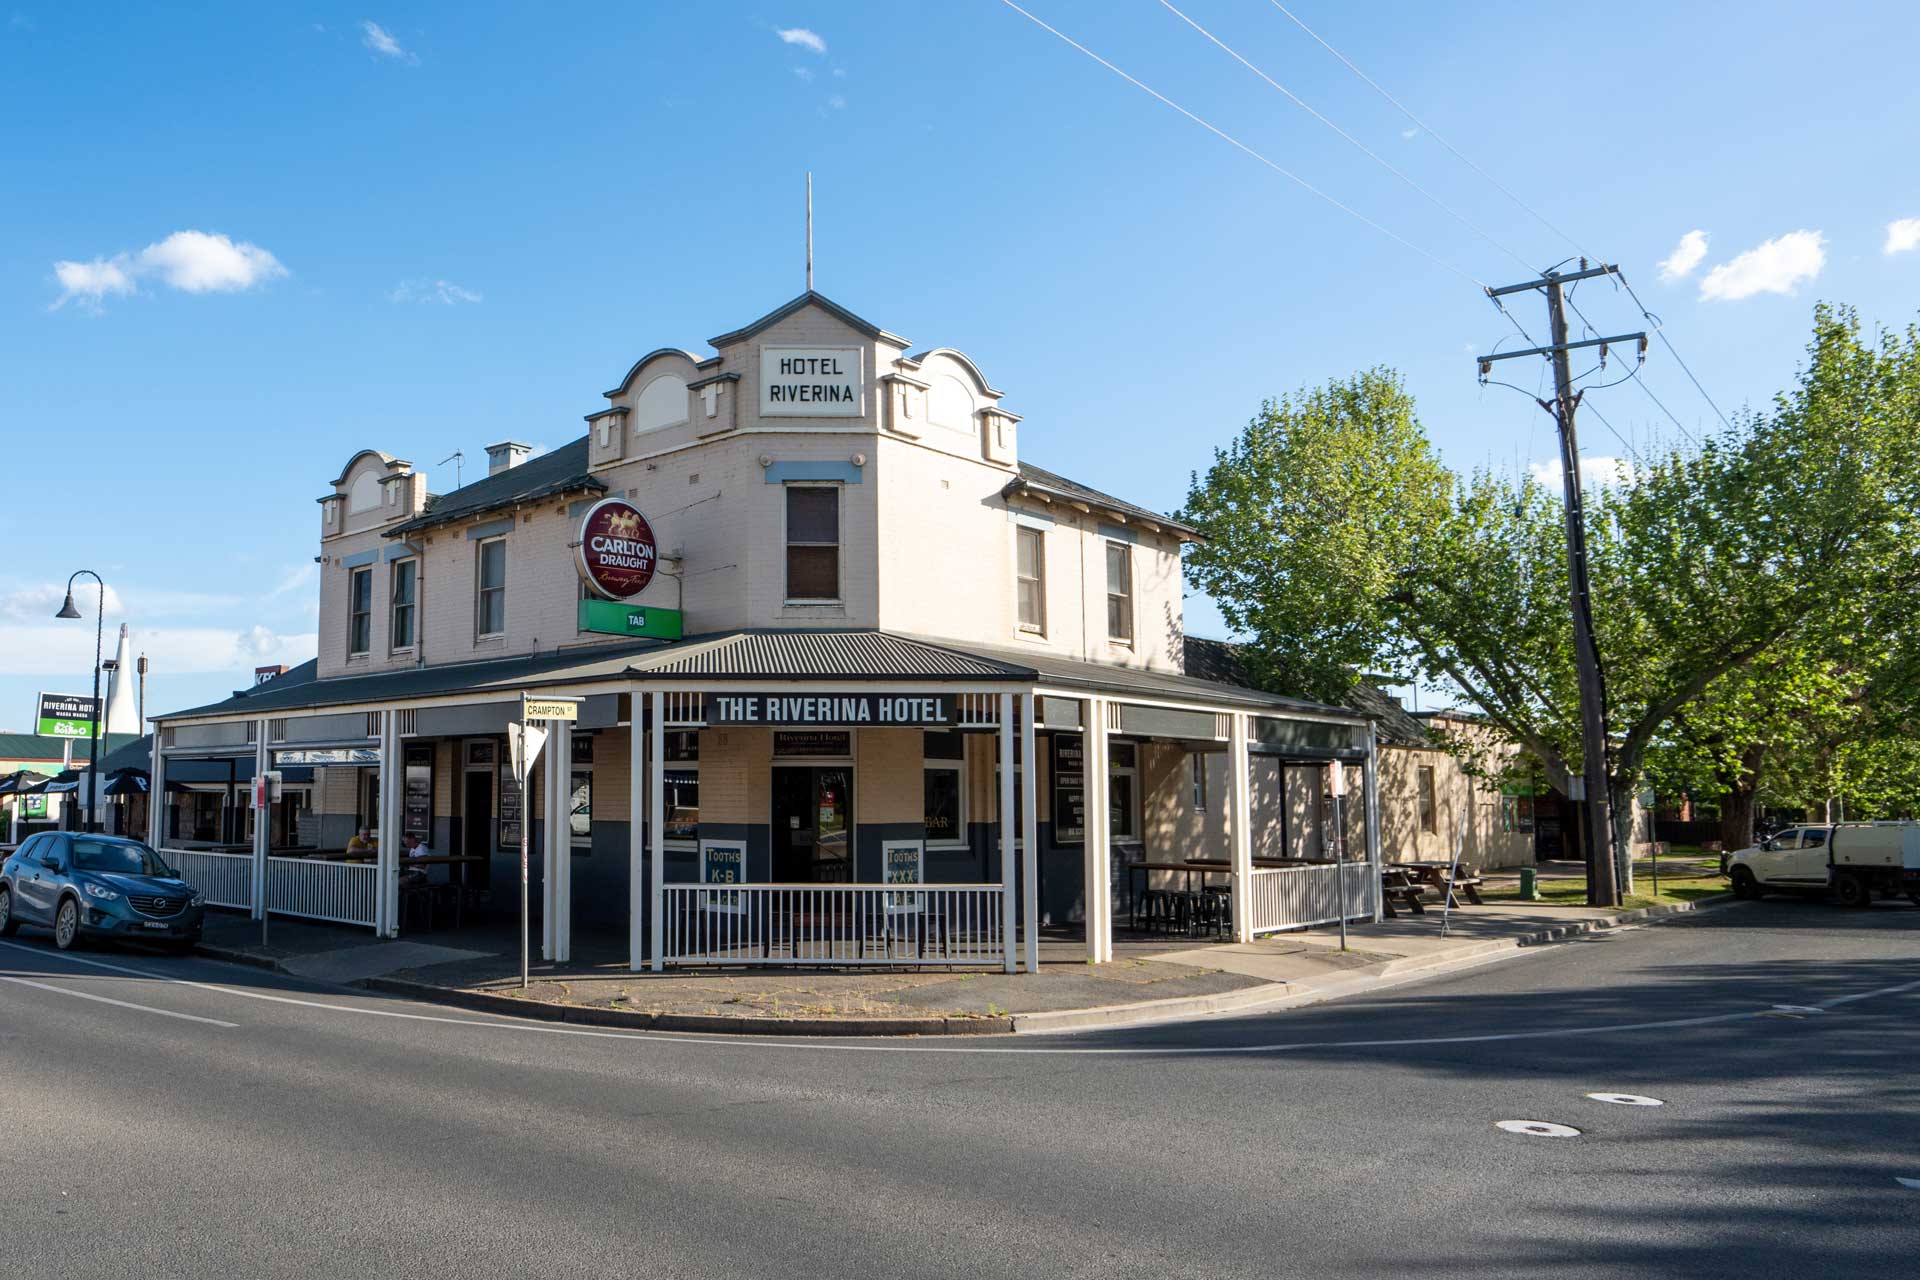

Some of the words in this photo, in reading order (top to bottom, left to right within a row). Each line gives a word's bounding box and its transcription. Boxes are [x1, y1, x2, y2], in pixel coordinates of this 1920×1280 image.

[780, 358, 843, 375] HOTEL
[770, 385, 854, 402] RIVERINA
[591, 536, 654, 560] CARLTON
[600, 553, 648, 570] DRAUGHT
[628, 614, 645, 626] TAB
[43, 701, 77, 711] RIVERINA
[527, 704, 565, 716] CRAMPTON
[716, 698, 758, 721] THE
[766, 698, 871, 721] RIVERINA
[879, 699, 947, 722] HOTEL
[925, 816, 949, 828] BAR
